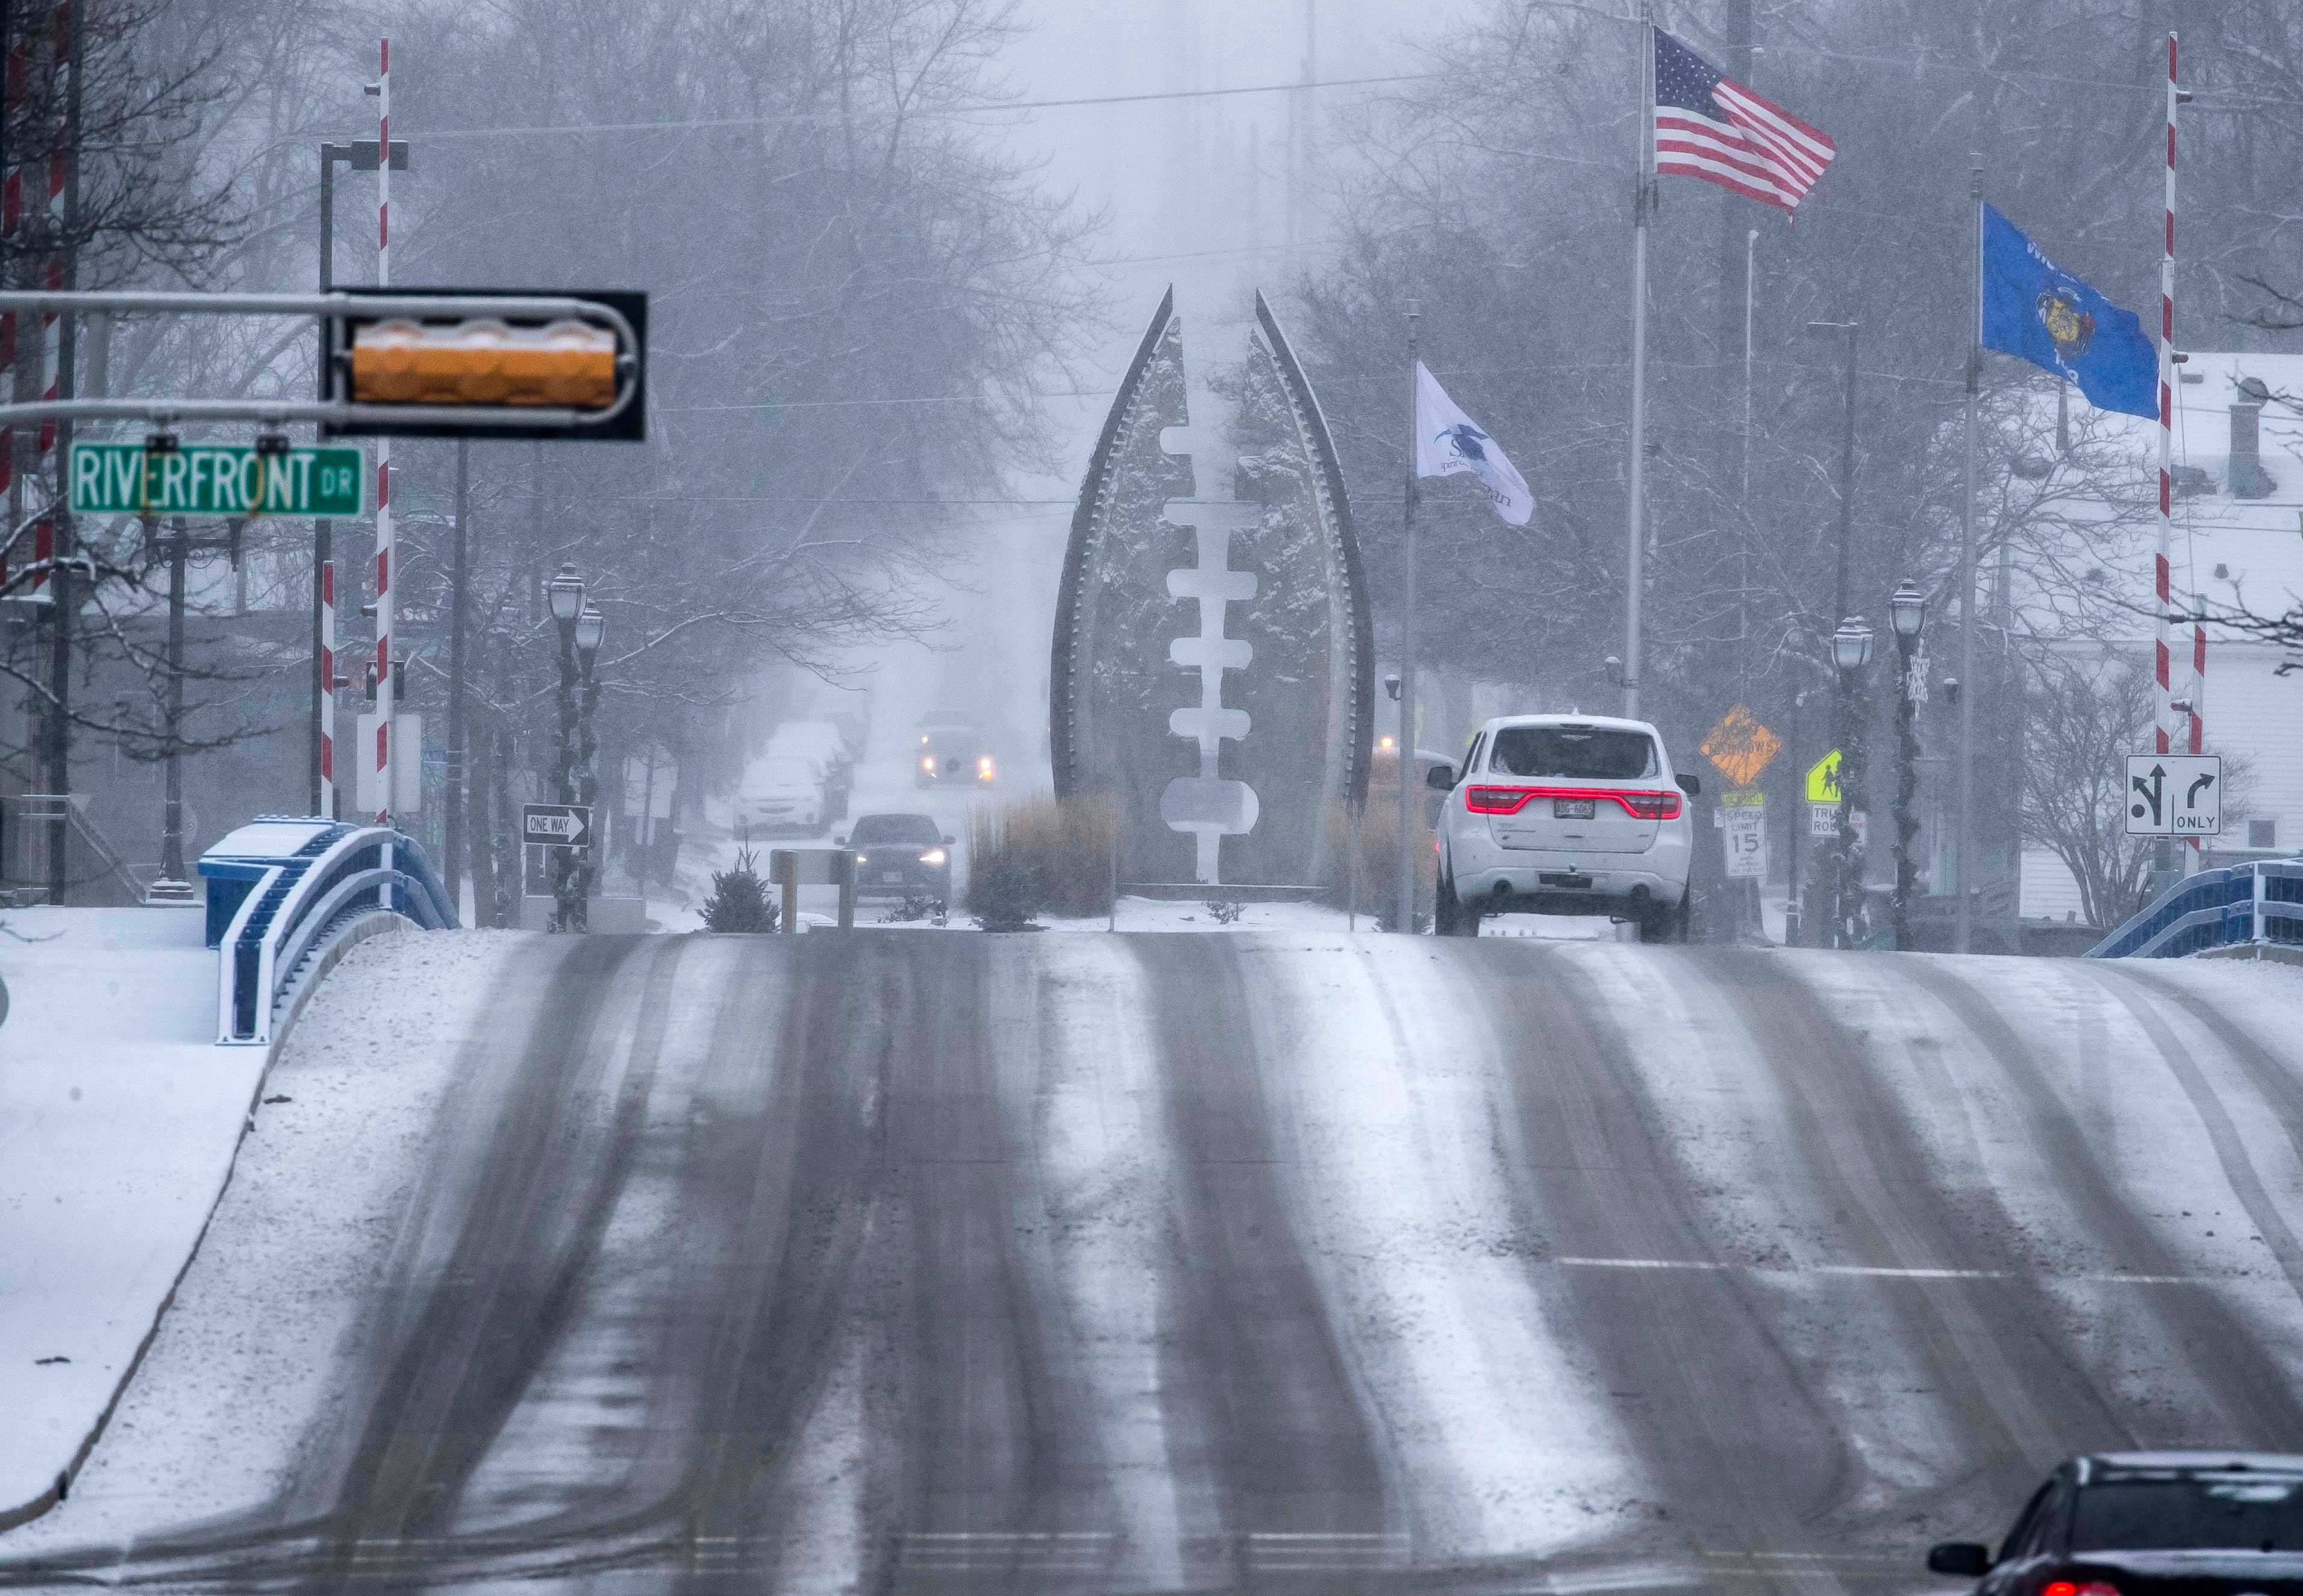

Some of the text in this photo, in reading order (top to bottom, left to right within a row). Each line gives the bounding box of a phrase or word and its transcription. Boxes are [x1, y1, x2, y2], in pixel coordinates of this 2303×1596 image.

[76, 450, 354, 509] RIVERFRONT DR
[1814, 808, 1837, 820] TRU
[530, 817, 569, 833] ONE WAY
[1732, 821, 1757, 831] LIMIT
[1814, 821, 1837, 832] ROU
[2176, 817, 2216, 828] ONLY
[1731, 834, 1758, 853] 15
